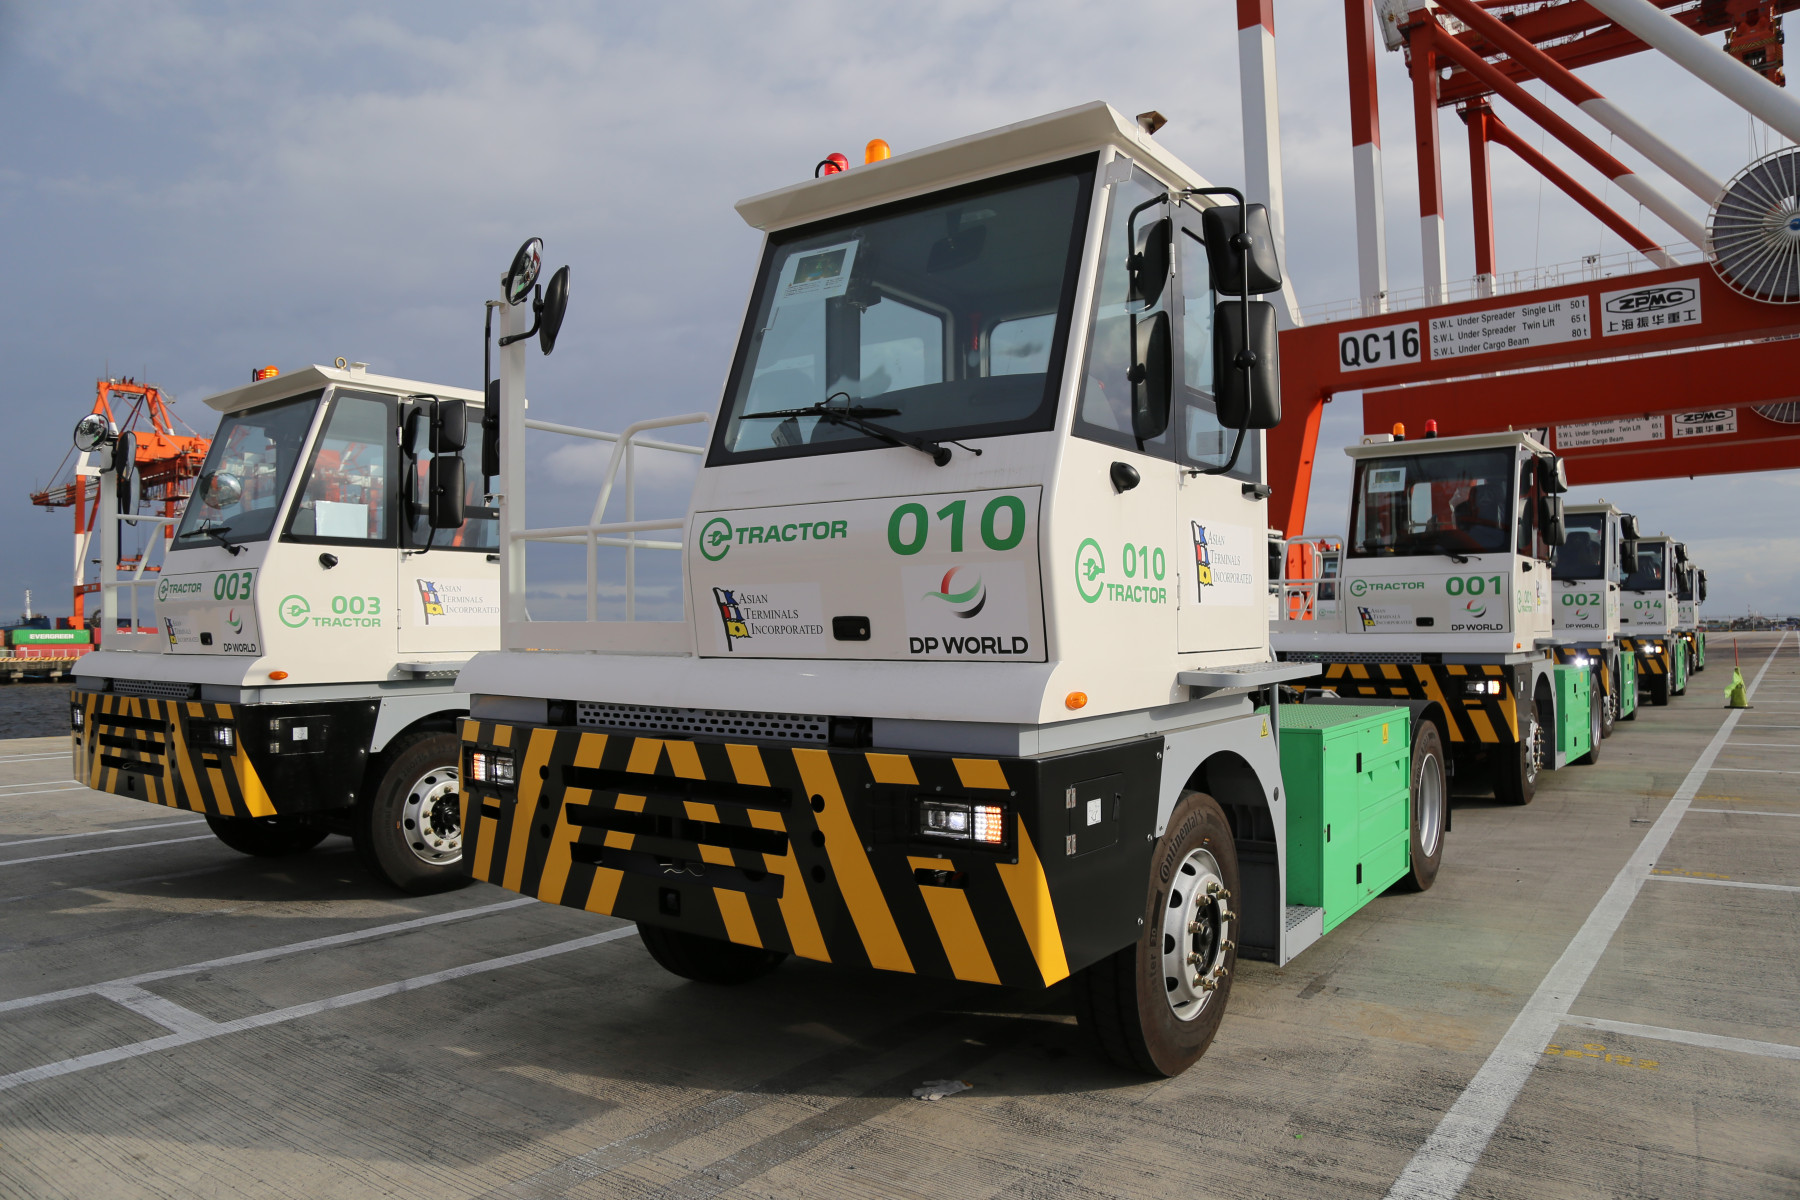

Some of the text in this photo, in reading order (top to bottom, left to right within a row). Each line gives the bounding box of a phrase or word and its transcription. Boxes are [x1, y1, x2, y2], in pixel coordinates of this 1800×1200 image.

[1618, 291, 1684, 310] ZPMC
[1457, 316, 1480, 326] Under
[1481, 310, 1516, 324] Spreader
[1522, 305, 1547, 317] Single
[1548, 302, 1561, 313] Lift
[1570, 300, 1580, 309] 50
[1582, 299, 1586, 308] t
[1606, 309, 1697, 333] 上海振华重工
[1457, 330, 1480, 340] Under
[1482, 324, 1517, 338] Spreader
[1522, 320, 1541, 331] Twin
[1542, 318, 1556, 328] Lift
[1571, 315, 1581, 324] 65
[1583, 314, 1587, 322] t
[1340, 327, 1420, 368] QC16
[1458, 344, 1481, 354] Under
[1483, 340, 1506, 351] Cargo
[1507, 337, 1530, 347] Beam
[1571, 329, 1582, 338] 80
[1583, 328, 1588, 337] t
[1683, 410, 1726, 422] ZPMC
[1575, 429, 1591, 437] Under
[1591, 427, 1615, 437] Spreader
[1619, 425, 1632, 433] Twin
[1575, 438, 1591, 446] Under
[1592, 436, 1609, 445] Cargo
[1609, 435, 1625, 443] Beam
[735, 520, 848, 545] TRACTOR
[887, 495, 1027, 556] 010
[1122, 542, 1166, 581] 010
[169, 582, 202, 594] TRACTOR
[214, 571, 253, 601] 003
[1107, 583, 1167, 604] TRACTOR
[1369, 581, 1425, 591] TRACTOR
[1445, 575, 1501, 596] 001
[331, 595, 381, 615] 003
[1561, 593, 1601, 606] 002
[1633, 600, 1663, 610] 014
[312, 617, 381, 628] TRACTOR
[1466, 623, 1504, 631] WORLD
[223, 643, 257, 653] DP WORLD
[910, 636, 1029, 655] DP WORLD
[1160, 810, 1200, 884] Continental
